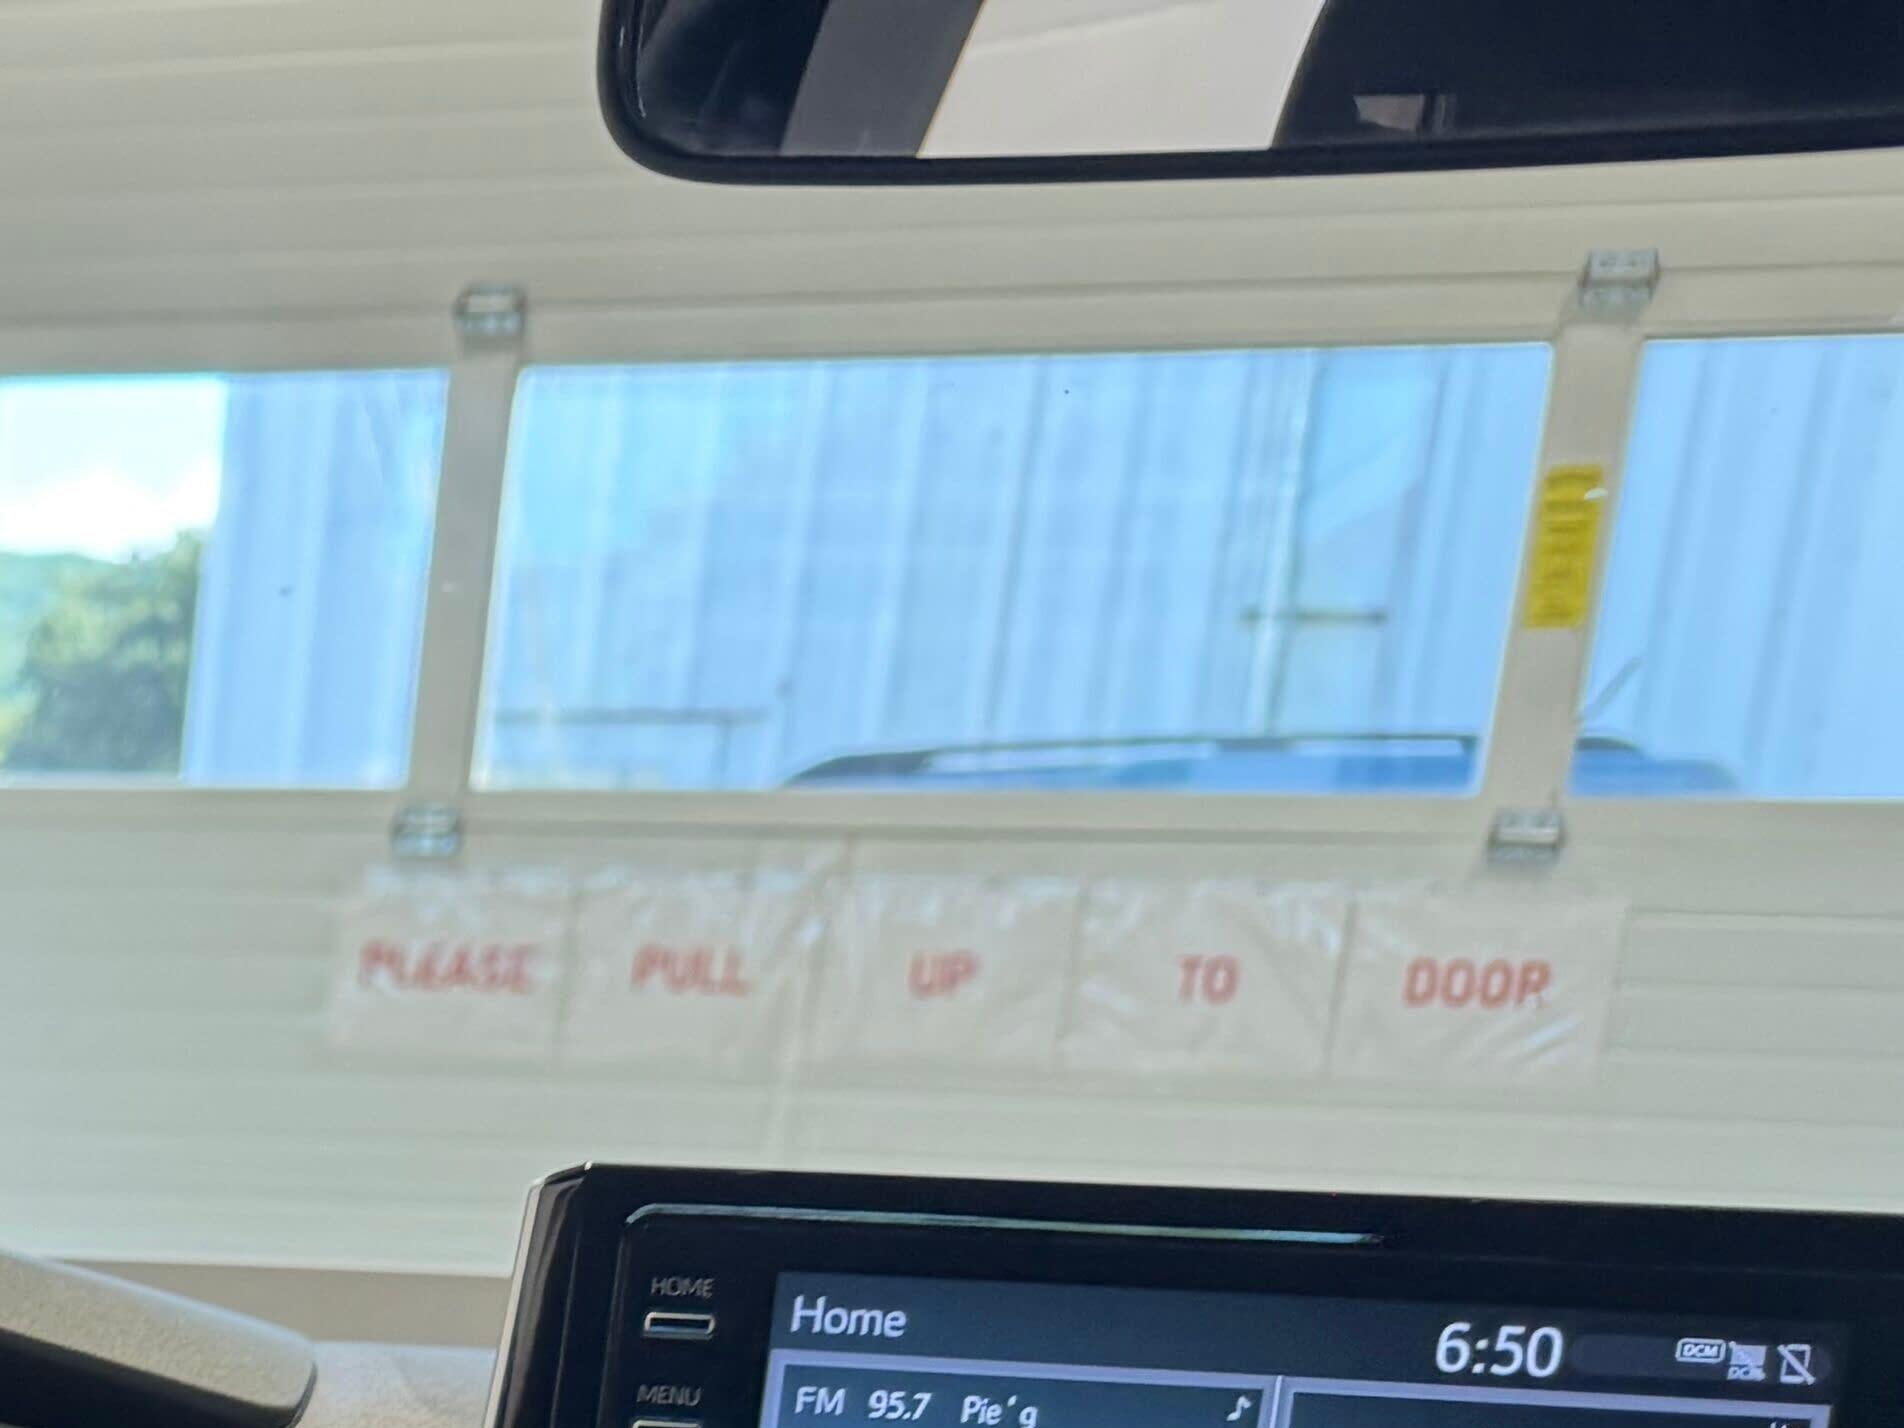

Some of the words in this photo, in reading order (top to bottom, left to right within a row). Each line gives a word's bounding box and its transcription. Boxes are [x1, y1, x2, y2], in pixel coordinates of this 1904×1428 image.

[359, 938, 544, 998] PLEASE
[631, 942, 754, 998] PULL
[907, 948, 982, 1002] UP
[1176, 953, 1242, 1004] TO
[1402, 956, 1555, 1010] DOOR
[650, 1274, 714, 1300] HOME
[789, 1294, 909, 1339] Home
[1434, 1320, 1565, 1379] 6:50
[636, 1383, 704, 1409] MENU
[793, 1385, 846, 1417] FM
[867, 1389, 933, 1422] 95.7
